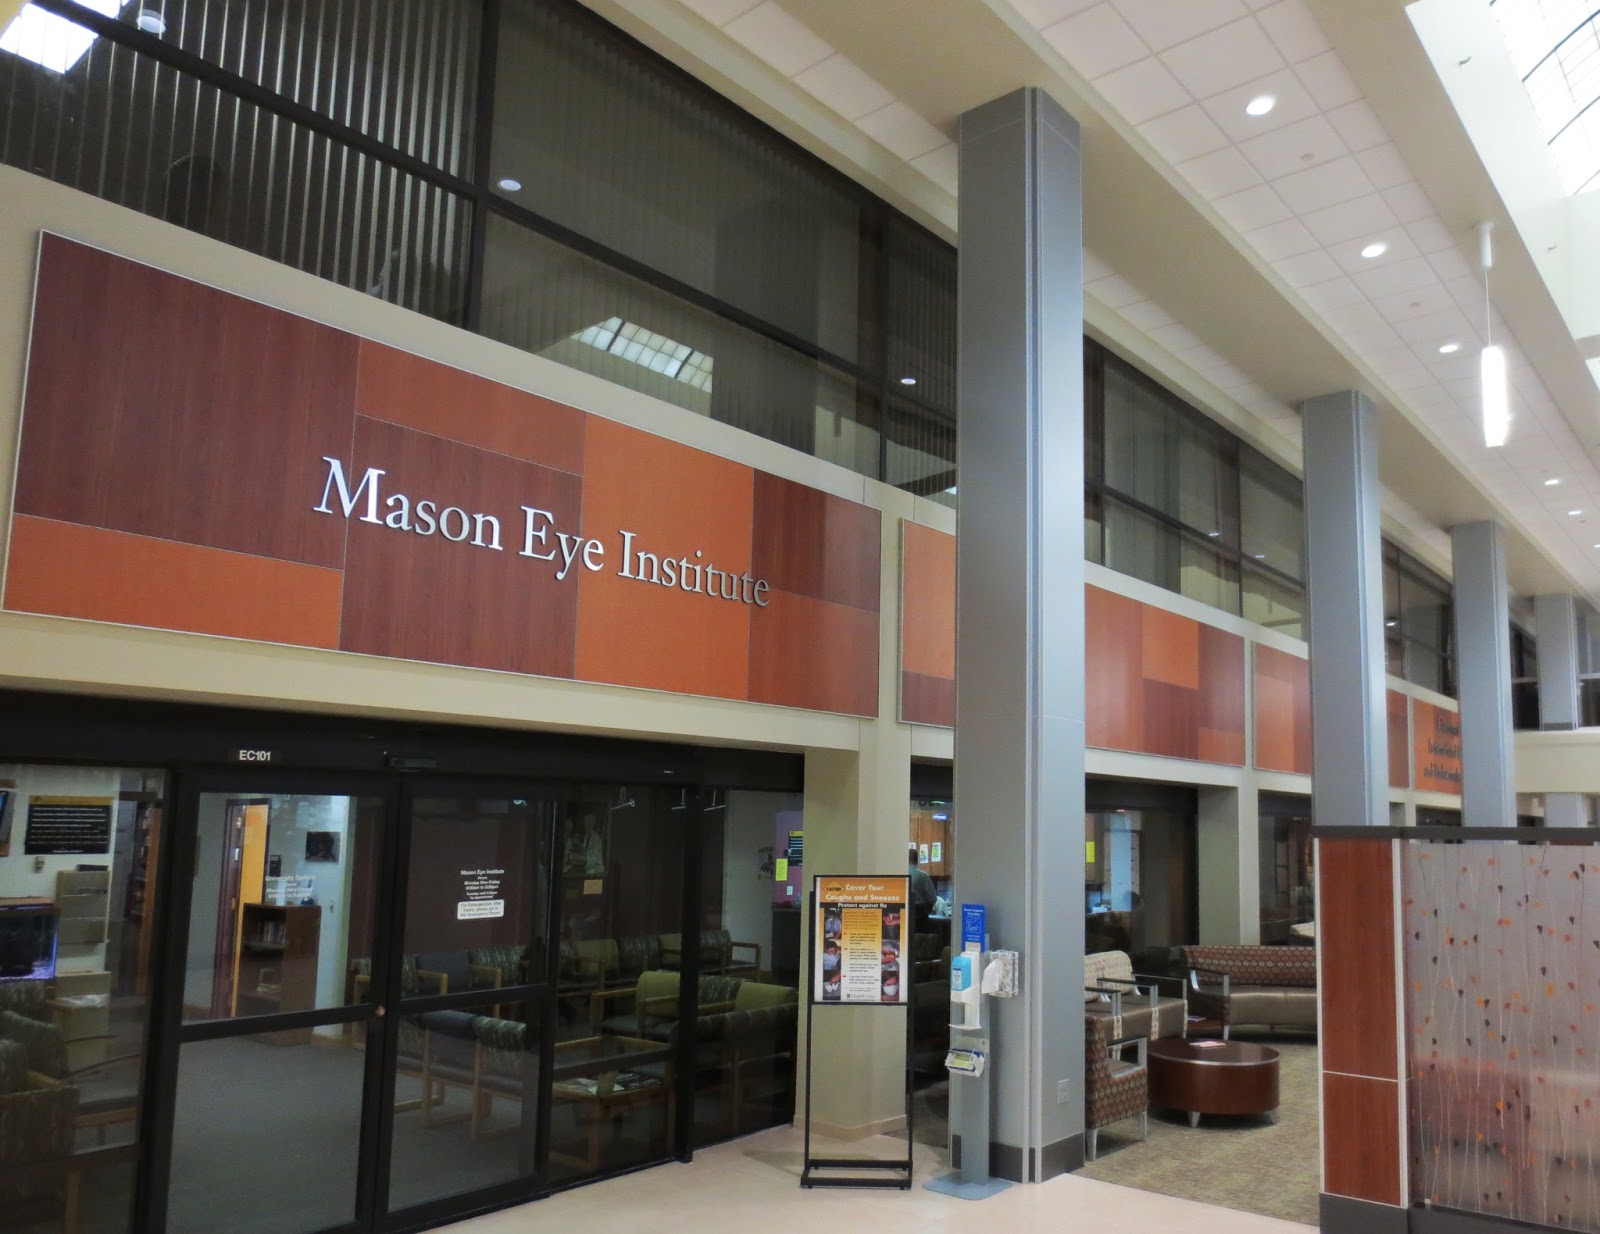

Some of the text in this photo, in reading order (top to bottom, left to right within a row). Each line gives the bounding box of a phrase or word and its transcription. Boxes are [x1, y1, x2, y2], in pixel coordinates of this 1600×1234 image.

[313, 456, 770, 607] Mason Eye Institute
[239, 750, 271, 761] EC101
[825, 894, 852, 902] Coughs
